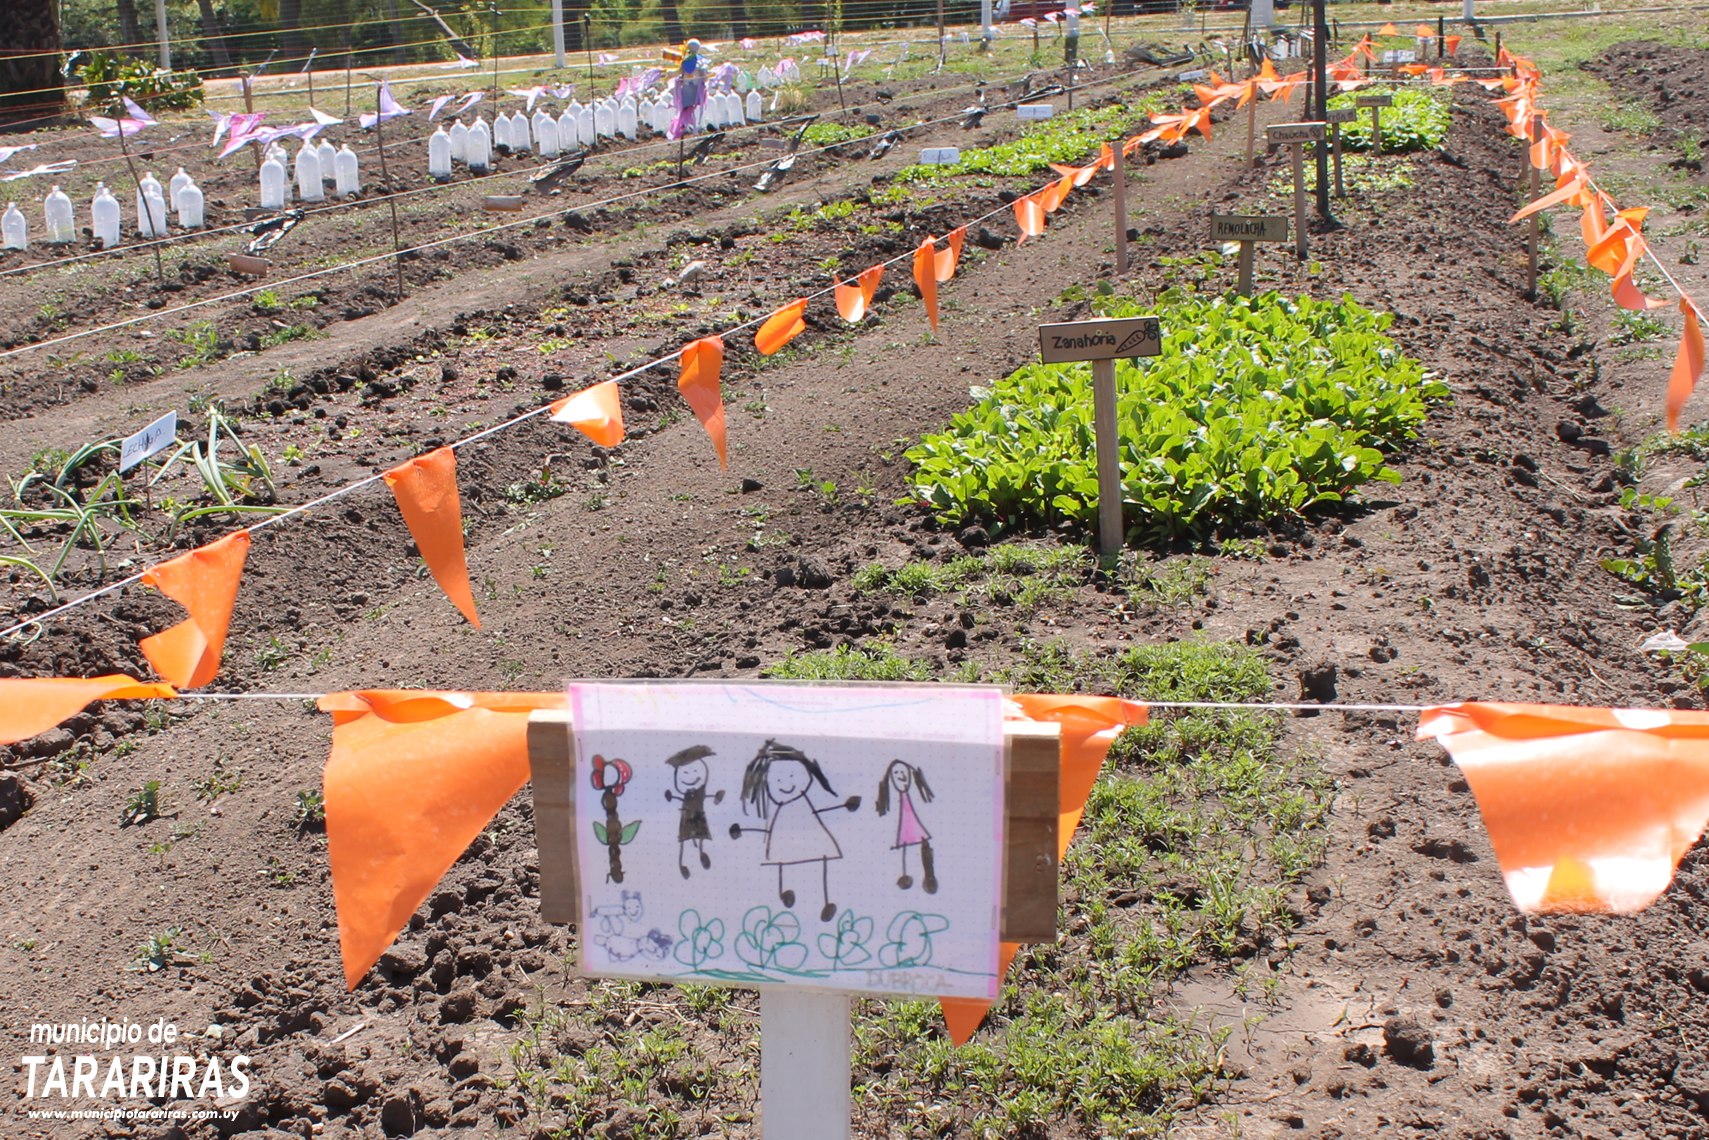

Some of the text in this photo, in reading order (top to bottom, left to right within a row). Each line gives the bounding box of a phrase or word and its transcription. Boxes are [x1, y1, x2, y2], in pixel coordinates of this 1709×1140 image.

[1272, 130, 1309, 140] Chaucha
[1217, 221, 1267, 236] REMOLACHA
[1052, 332, 1116, 349] Zanahoria
